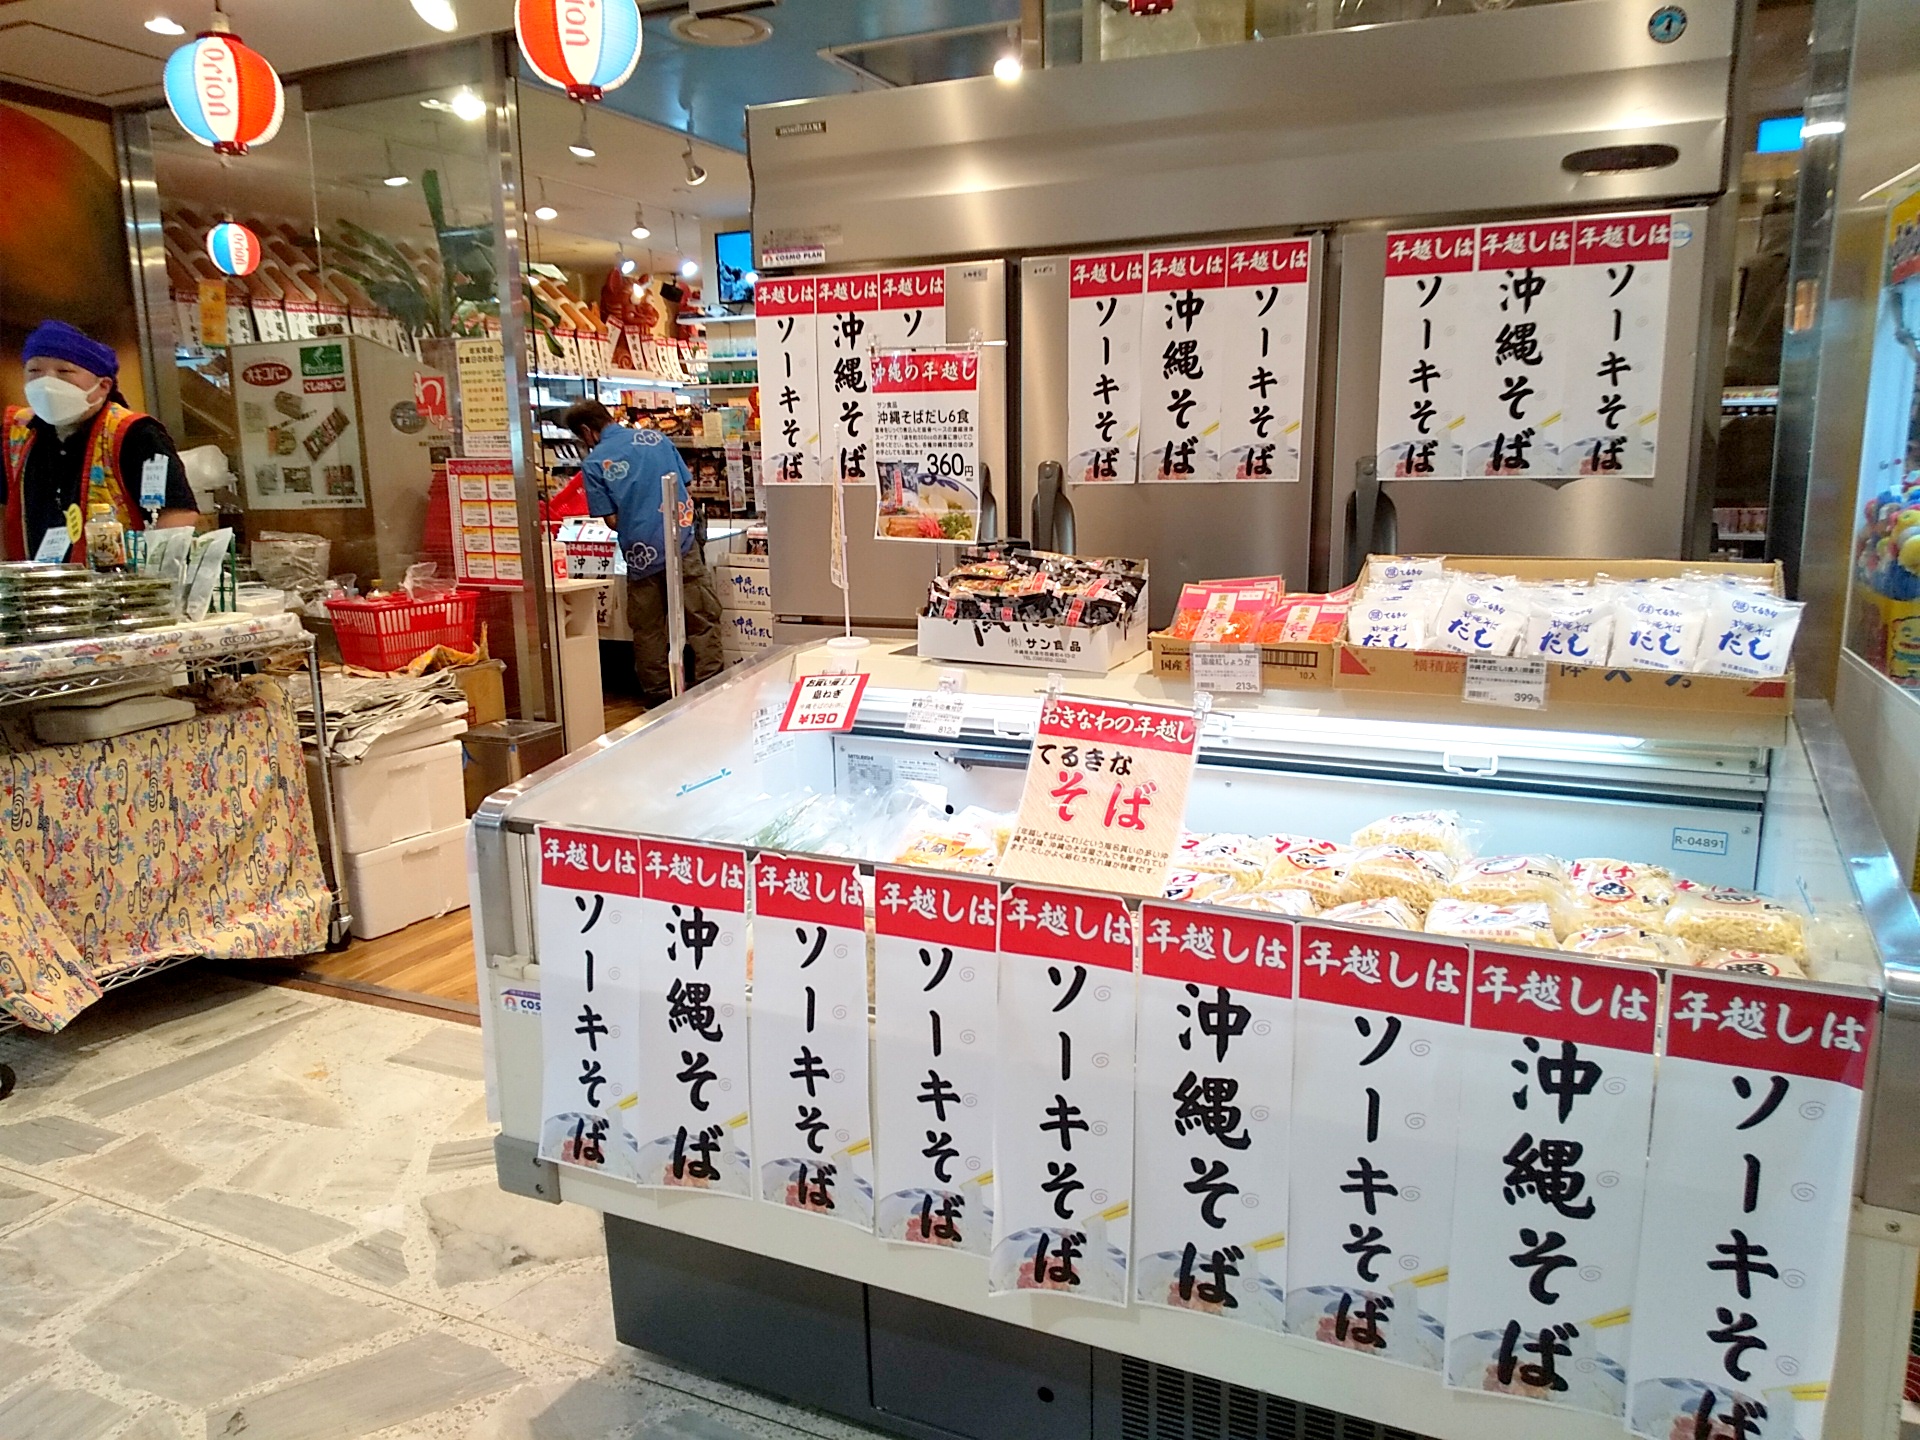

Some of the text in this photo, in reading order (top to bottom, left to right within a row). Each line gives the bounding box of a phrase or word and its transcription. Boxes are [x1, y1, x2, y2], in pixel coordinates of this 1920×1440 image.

[203, 48, 232, 116] Orion
[1389, 238, 1473, 262] 年越しは
[1481, 230, 1570, 254] 年越しは
[1578, 223, 1669, 247] 年越しは
[1073, 261, 1143, 284] 年越しは
[1150, 255, 1223, 278] 年越しは
[1230, 249, 1308, 273] 年越しは
[757, 285, 814, 305] 年越しは
[818, 280, 878, 302] 年越しは
[882, 276, 944, 298] 年越しは
[872, 360, 976, 385] 沖縄の年越し
[1093, 297, 1120, 479] ソーキそば
[1162, 289, 1204, 476] 沖縄そば
[1245, 286, 1279, 477] ソーキそば
[1405, 276, 1442, 474] ソーキそば
[1492, 267, 1545, 472] 沖縄そば
[1592, 264, 1634, 472] ソーキそば
[778, 317, 804, 480] ソーキそば
[833, 311, 867, 480] 沖縄そば
[877, 401, 898, 409] サン食品
[878, 409, 969, 425] 沖縄そばだし6食
[927, 453, 973, 476] 360円
[1026, 638, 1081, 652] サン食品
[1362, 633, 1408, 648] だし
[1448, 619, 1493, 648] だし
[1539, 631, 1589, 657] だし
[1629, 630, 1681, 656] だし
[1718, 630, 1772, 661] だし
[1201, 658, 1251, 666] 国産紅しょうが
[1300, 671, 1317, 681] 10入
[798, 713, 838, 724] ¥130
[1042, 706, 1195, 744] おきなわの年越し
[1037, 744, 1133, 776] てるきな
[1050, 771, 1157, 831] そば
[543, 838, 636, 874] 年越しは
[1675, 835, 1725, 849] R-04891
[645, 850, 744, 890] 年越しは
[757, 865, 863, 907] 年越しは
[880, 881, 995, 927] 年越しは
[1005, 897, 1131, 945] 年越しは
[1146, 918, 1288, 970] 年越しは
[1304, 939, 1460, 994] 年越しは
[1477, 965, 1650, 1021] 年越しは
[572, 894, 609, 1165] ソーキそば
[1674, 990, 1867, 1054] 年越しは
[665, 904, 724, 1182] 沖縄そば
[788, 926, 837, 1210] ソーキそば
[916, 947, 965, 1243] ソーキそば
[1033, 965, 1090, 1286] ソーキそば
[1172, 983, 1252, 1309] 沖縄そば
[1335, 1016, 1401, 1350] ソーキそば
[1497, 1036, 1603, 1393] 沖縄そば
[1694, 1075, 1790, 1440] ソーキそば
